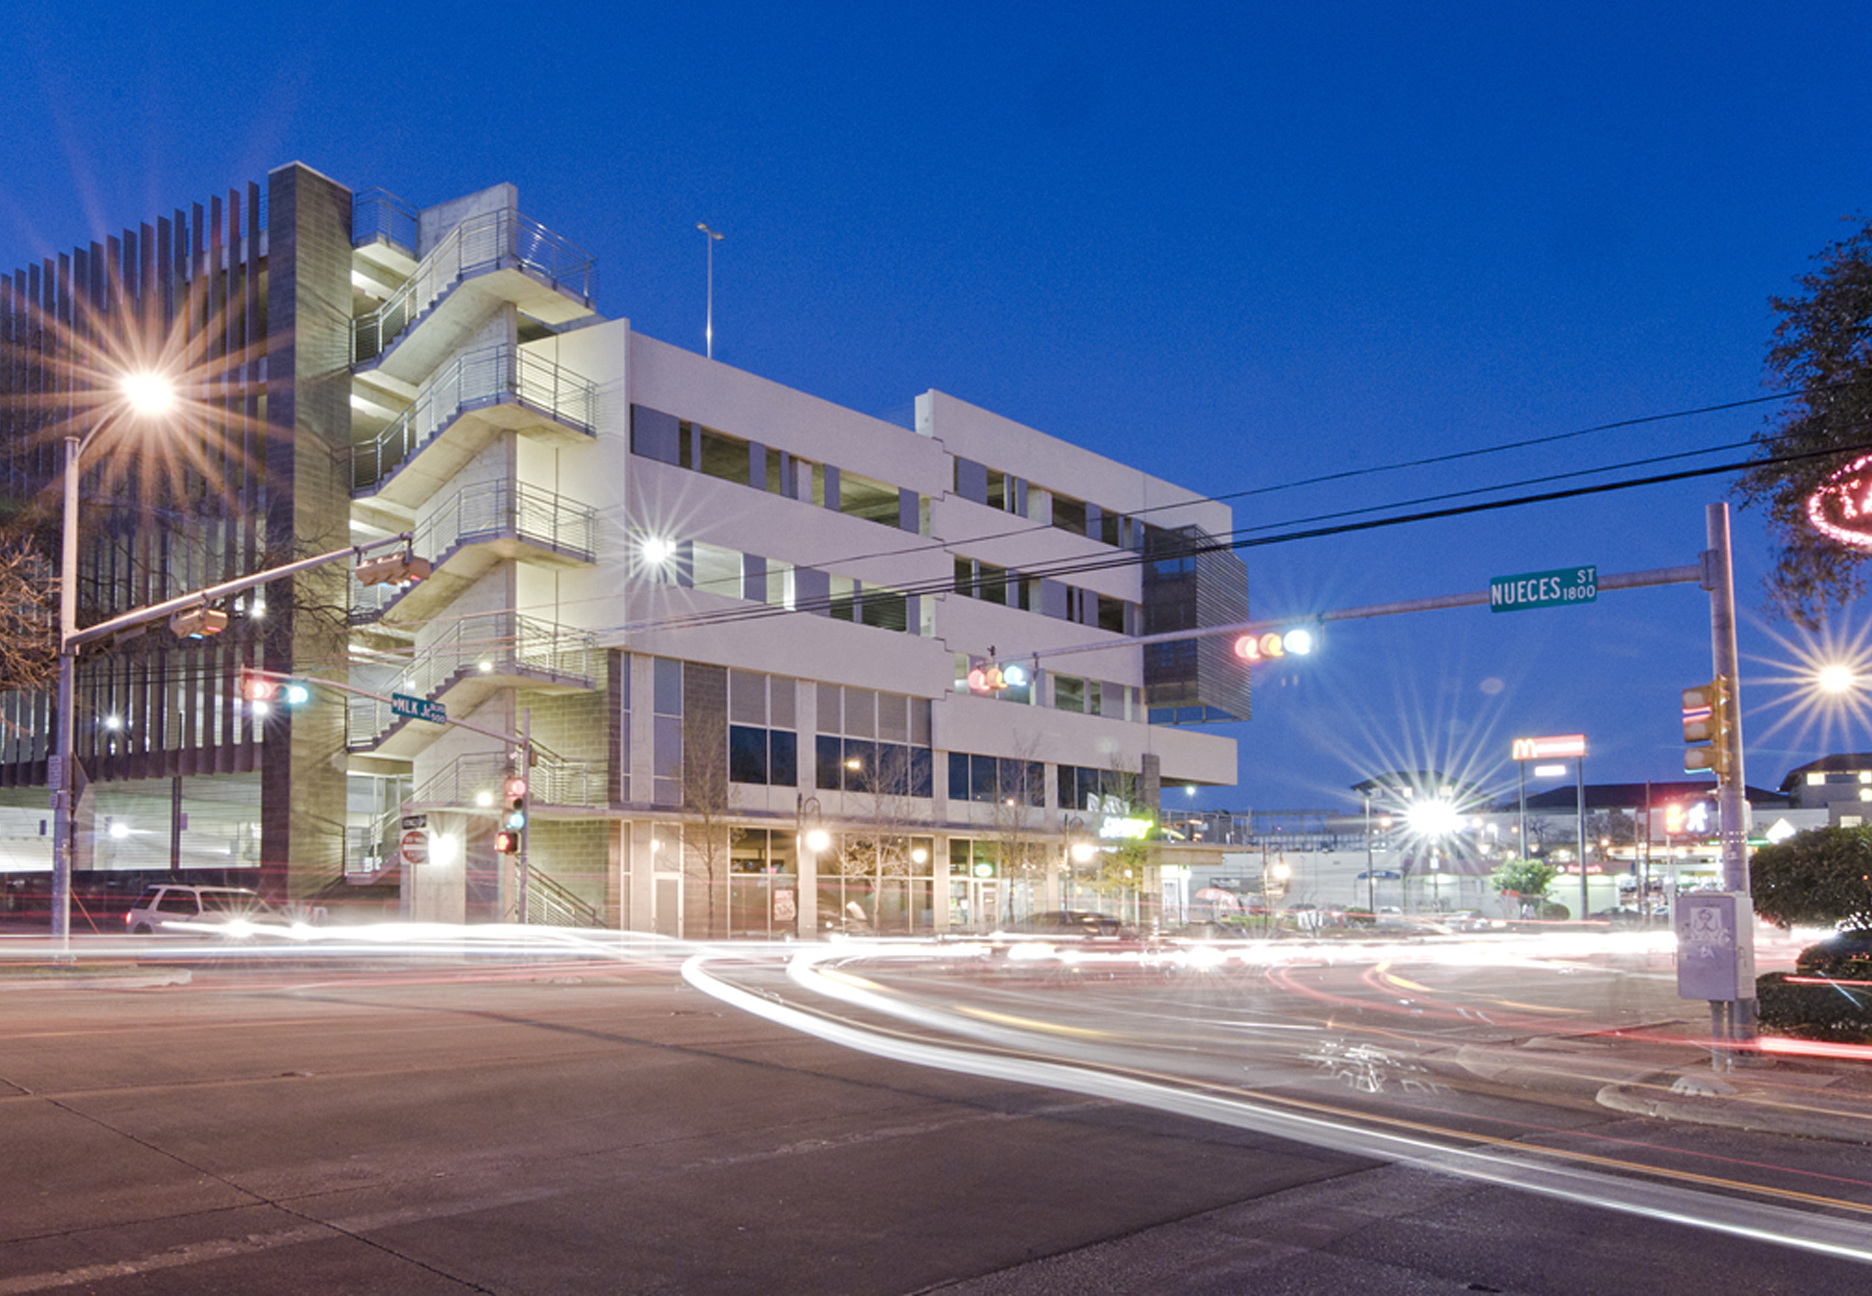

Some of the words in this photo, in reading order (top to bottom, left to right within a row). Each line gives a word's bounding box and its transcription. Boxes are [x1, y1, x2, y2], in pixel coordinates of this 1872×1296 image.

[1577, 568, 1595, 584] ST
[1491, 577, 1560, 606] NUECES
[1563, 585, 1595, 600] 1800
[397, 698, 418, 715] MLK
